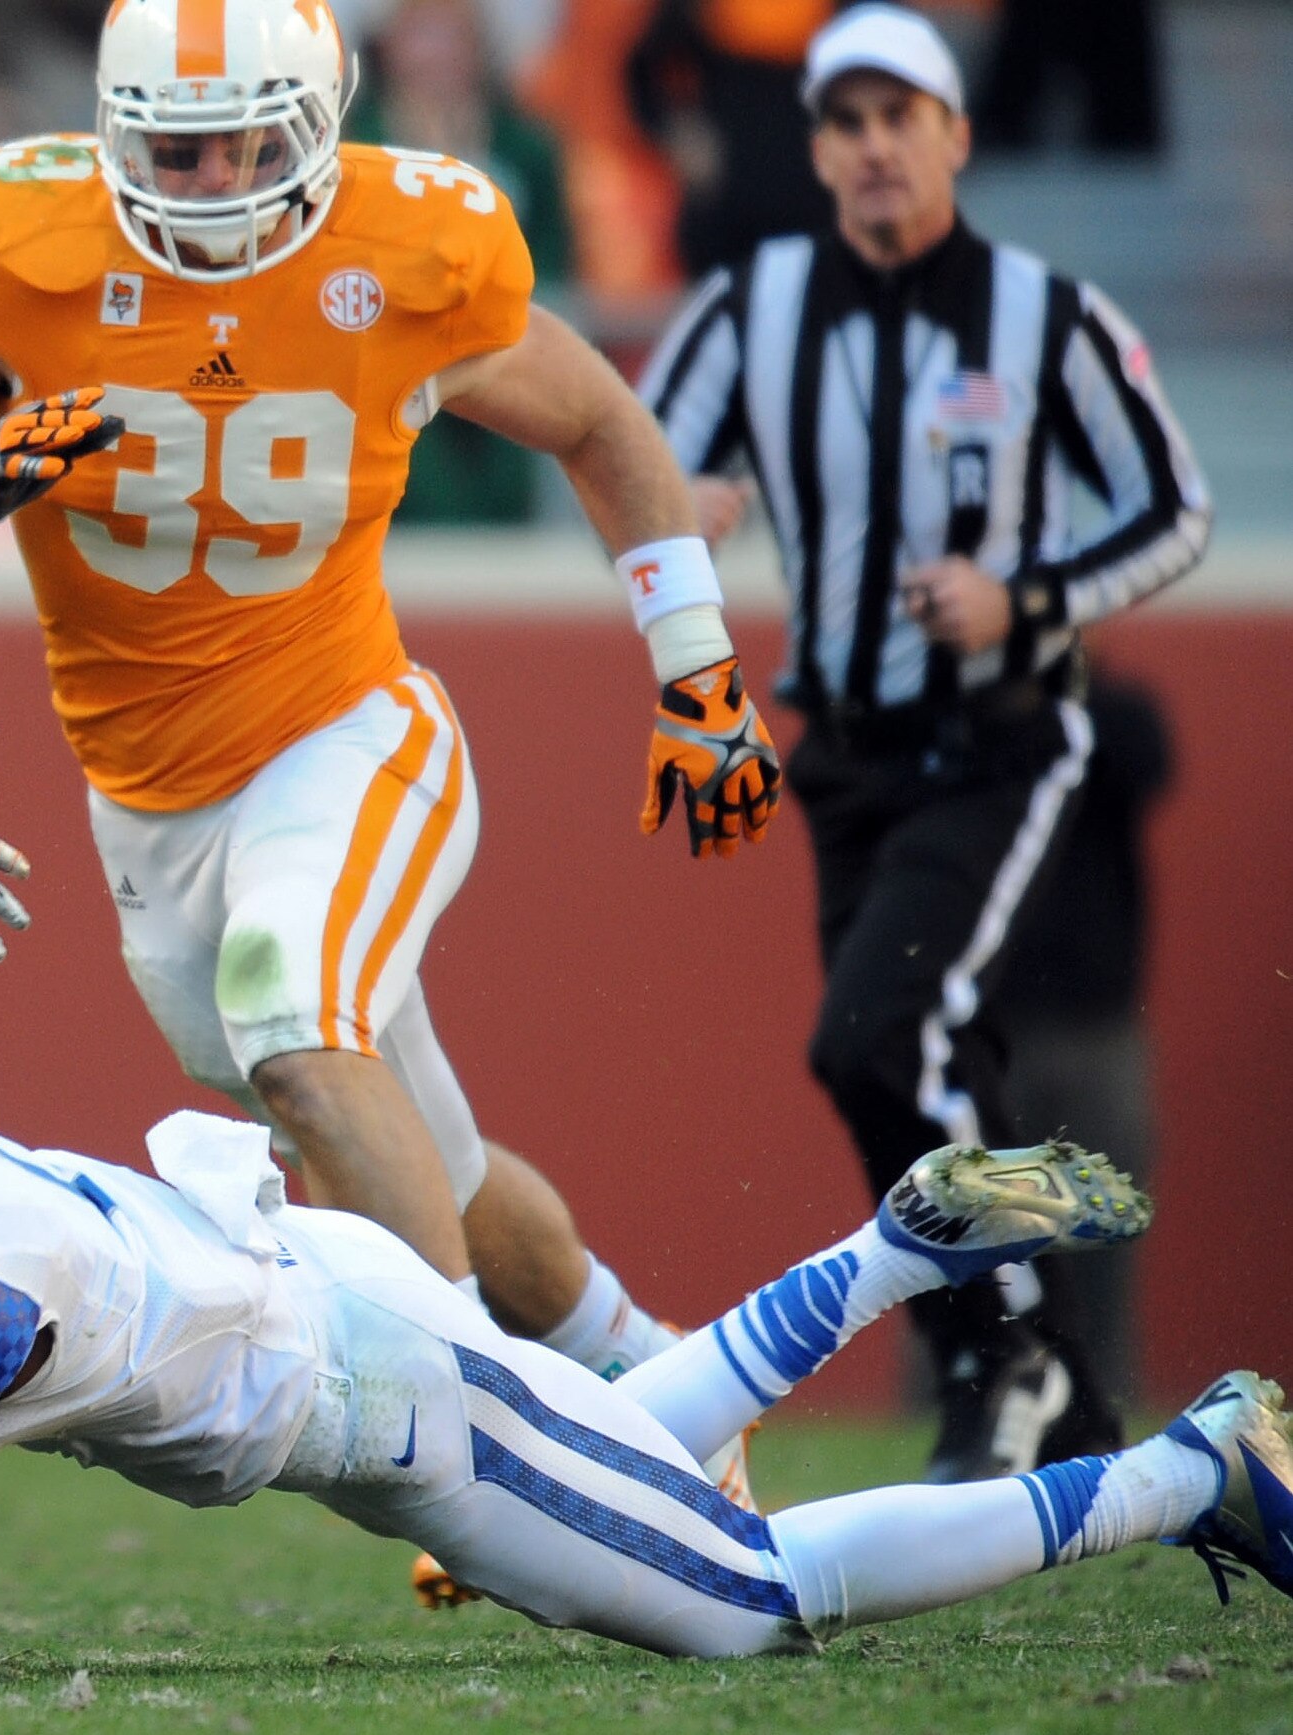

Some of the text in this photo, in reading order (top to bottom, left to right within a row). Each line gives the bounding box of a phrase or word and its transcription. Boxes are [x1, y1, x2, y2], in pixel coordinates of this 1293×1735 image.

[321, 269, 384, 331] SEC
[208, 314, 240, 345] T
[189, 371, 245, 388] adidas
[64, 383, 357, 598] 39
[630, 562, 661, 596] T
